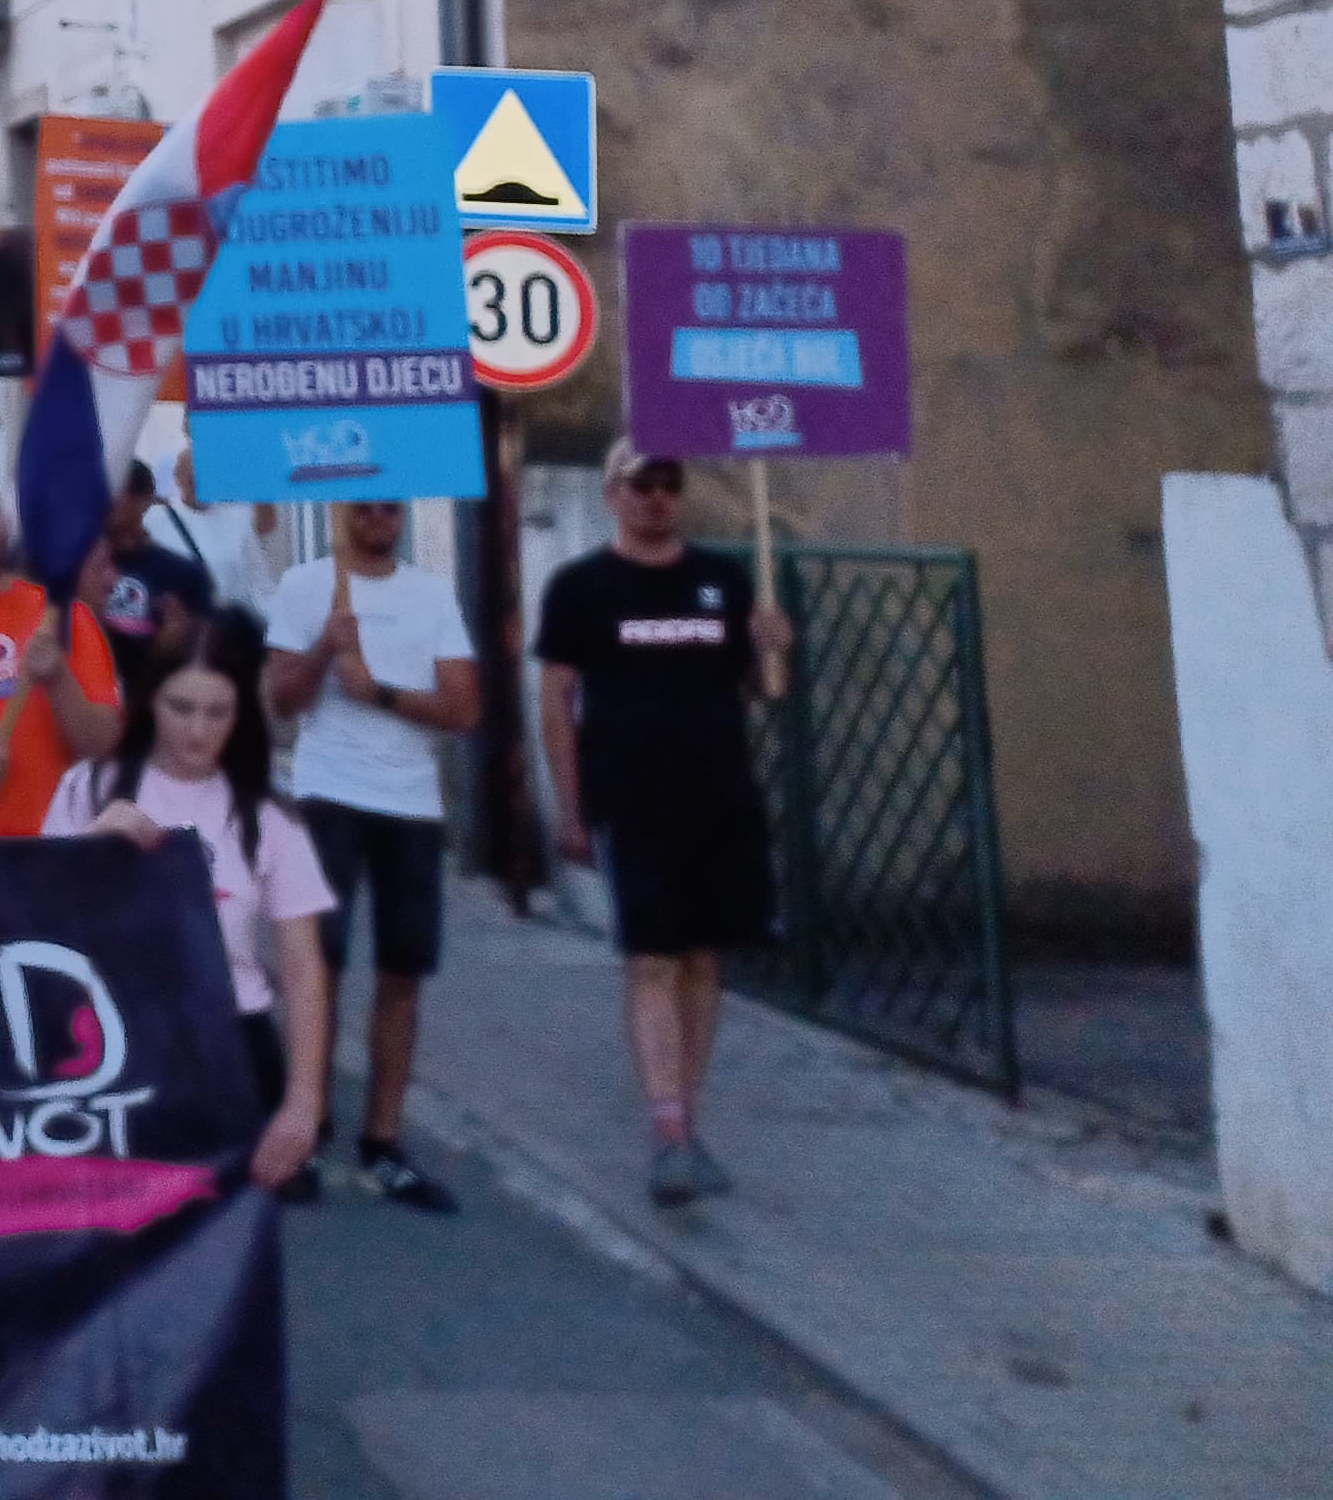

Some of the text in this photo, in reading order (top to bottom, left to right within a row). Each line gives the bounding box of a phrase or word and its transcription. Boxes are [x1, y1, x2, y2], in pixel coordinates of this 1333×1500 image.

[249, 258, 389, 293] MANJINU
[468, 270, 561, 346] 30
[222, 314, 240, 349] U
[364, 354, 464, 397] DJECU
